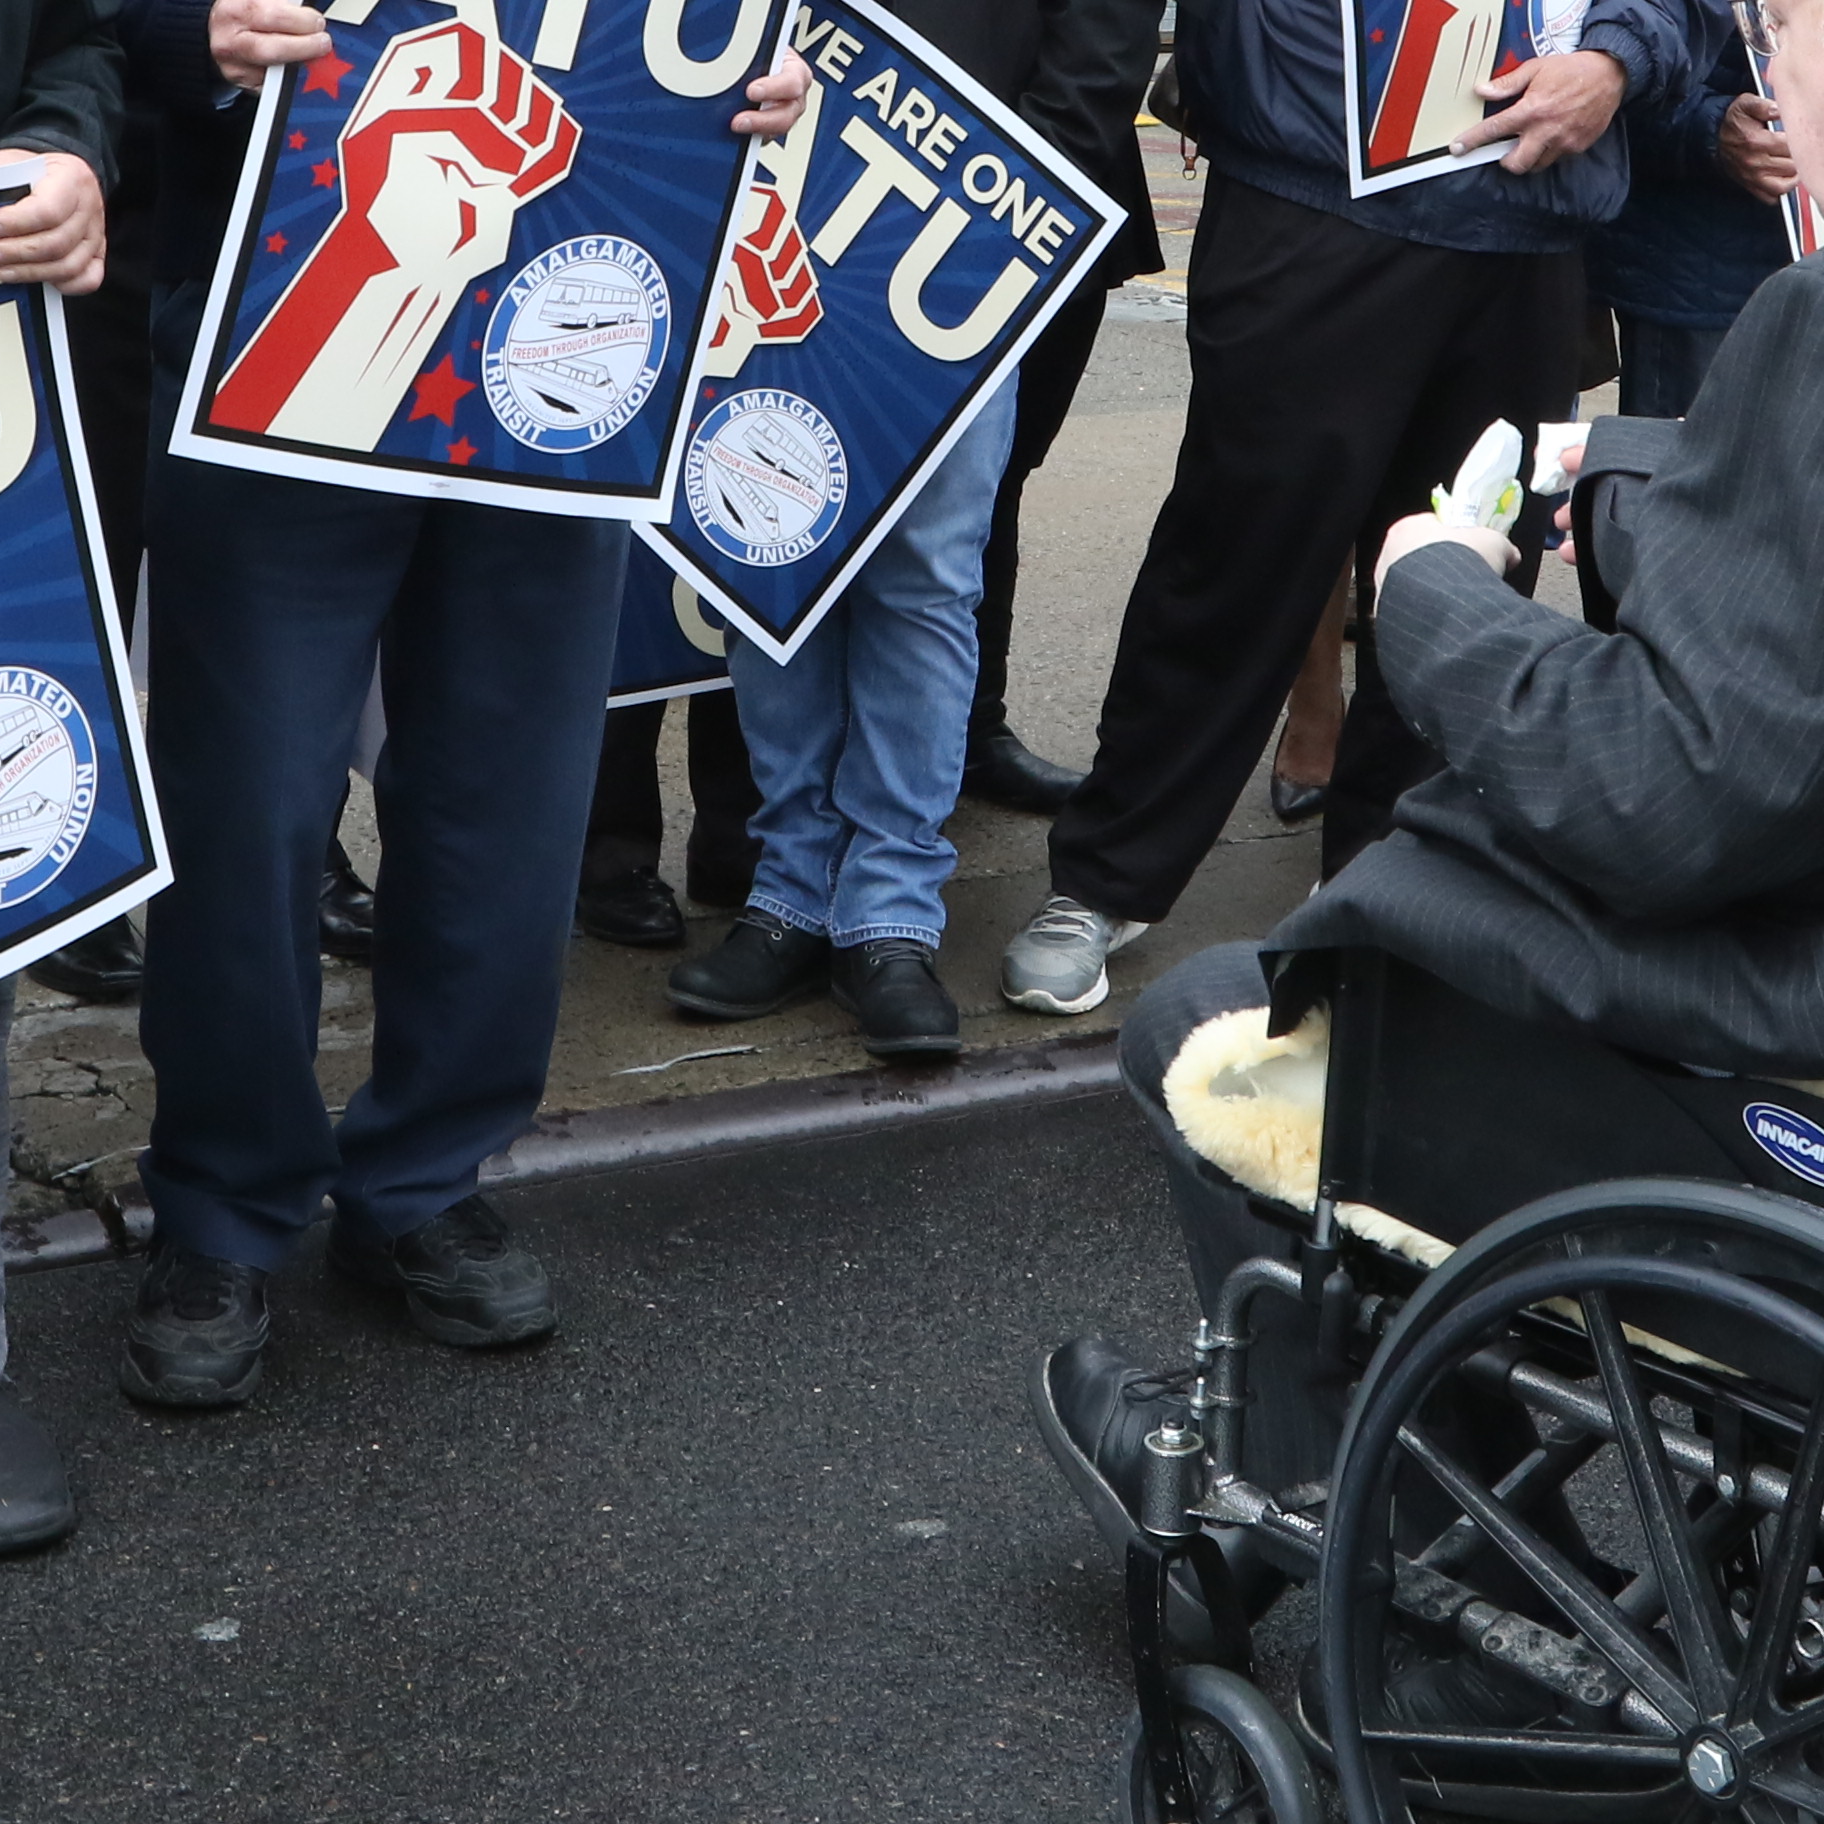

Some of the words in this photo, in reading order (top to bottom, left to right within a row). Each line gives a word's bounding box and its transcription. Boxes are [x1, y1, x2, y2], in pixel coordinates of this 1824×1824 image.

[852, 67, 969, 171] ARE
[962, 153, 1076, 265] ONE
[509, 240, 667, 321] AMALGAMATED
[511, 341, 549, 359] FREEDOM
[552, 335, 588, 355] THROUGH
[591, 327, 646, 346] ORGANIZATION
[486, 346, 547, 444] TRANSIT
[589, 366, 657, 441] UNION
[687, 439, 717, 528] TRANSIT
[728, 392, 844, 504] AMALGAMATED
[772, 476, 820, 507] ORGANIZATION
[746, 532, 815, 563] UNION
[4, 732, 61, 782] ORGANIZATION
[48, 762, 93, 865] UNION
